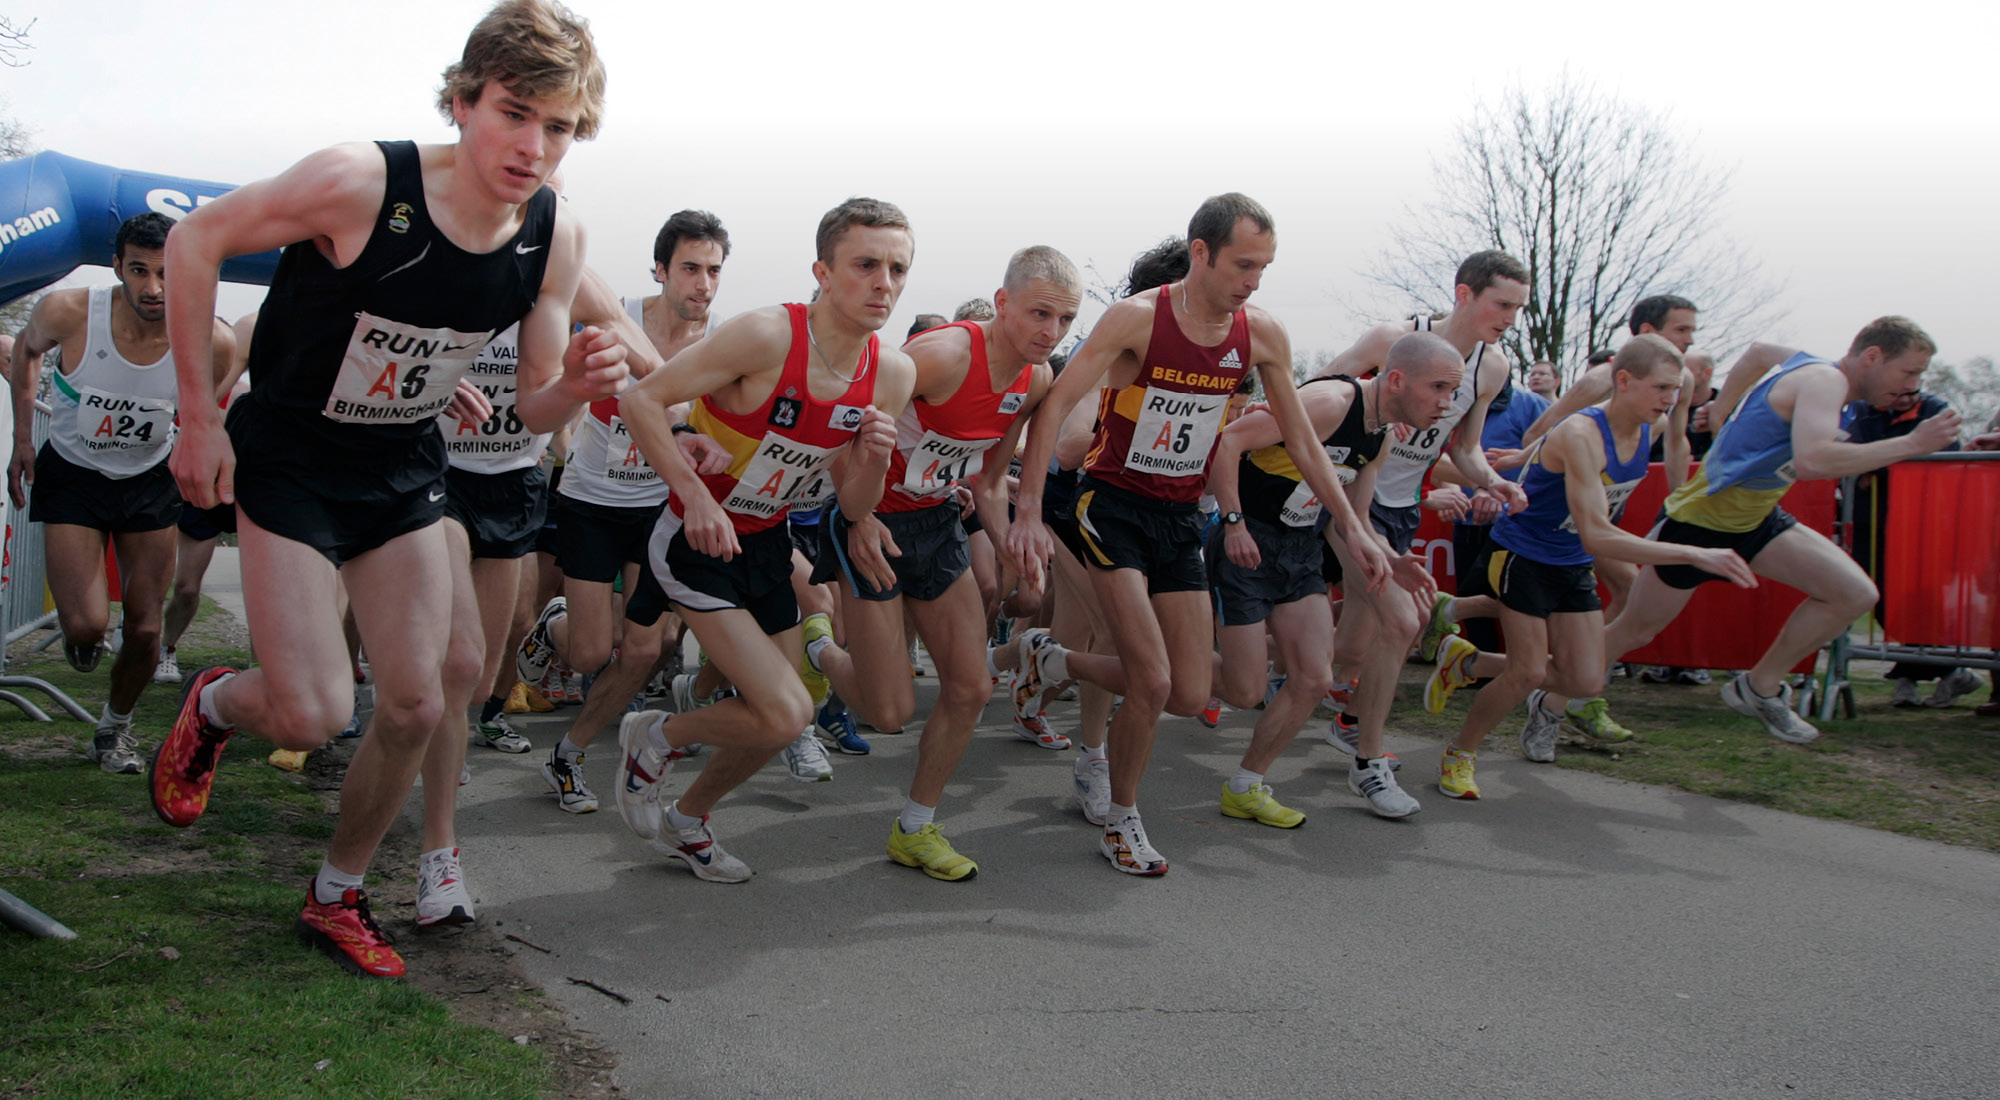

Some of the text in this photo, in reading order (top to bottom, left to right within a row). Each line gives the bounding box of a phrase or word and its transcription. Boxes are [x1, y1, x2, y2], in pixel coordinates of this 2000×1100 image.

[0, 206, 61, 254] ham
[361, 328, 440, 359] RUN
[366, 361, 430, 400] A6
[1152, 366, 1238, 390] BELGRAVE
[86, 395, 136, 411] RUN
[333, 397, 449, 417] BIRMINGHAM
[1148, 395, 1196, 417] RUN
[95, 414, 154, 442] A24
[1152, 421, 1193, 454] A5
[446, 437, 531, 453] IRMINGHAM
[762, 443, 820, 469] RUN
[920, 440, 972, 459] RUN
[1131, 452, 1204, 472] BIRMINGHAM
